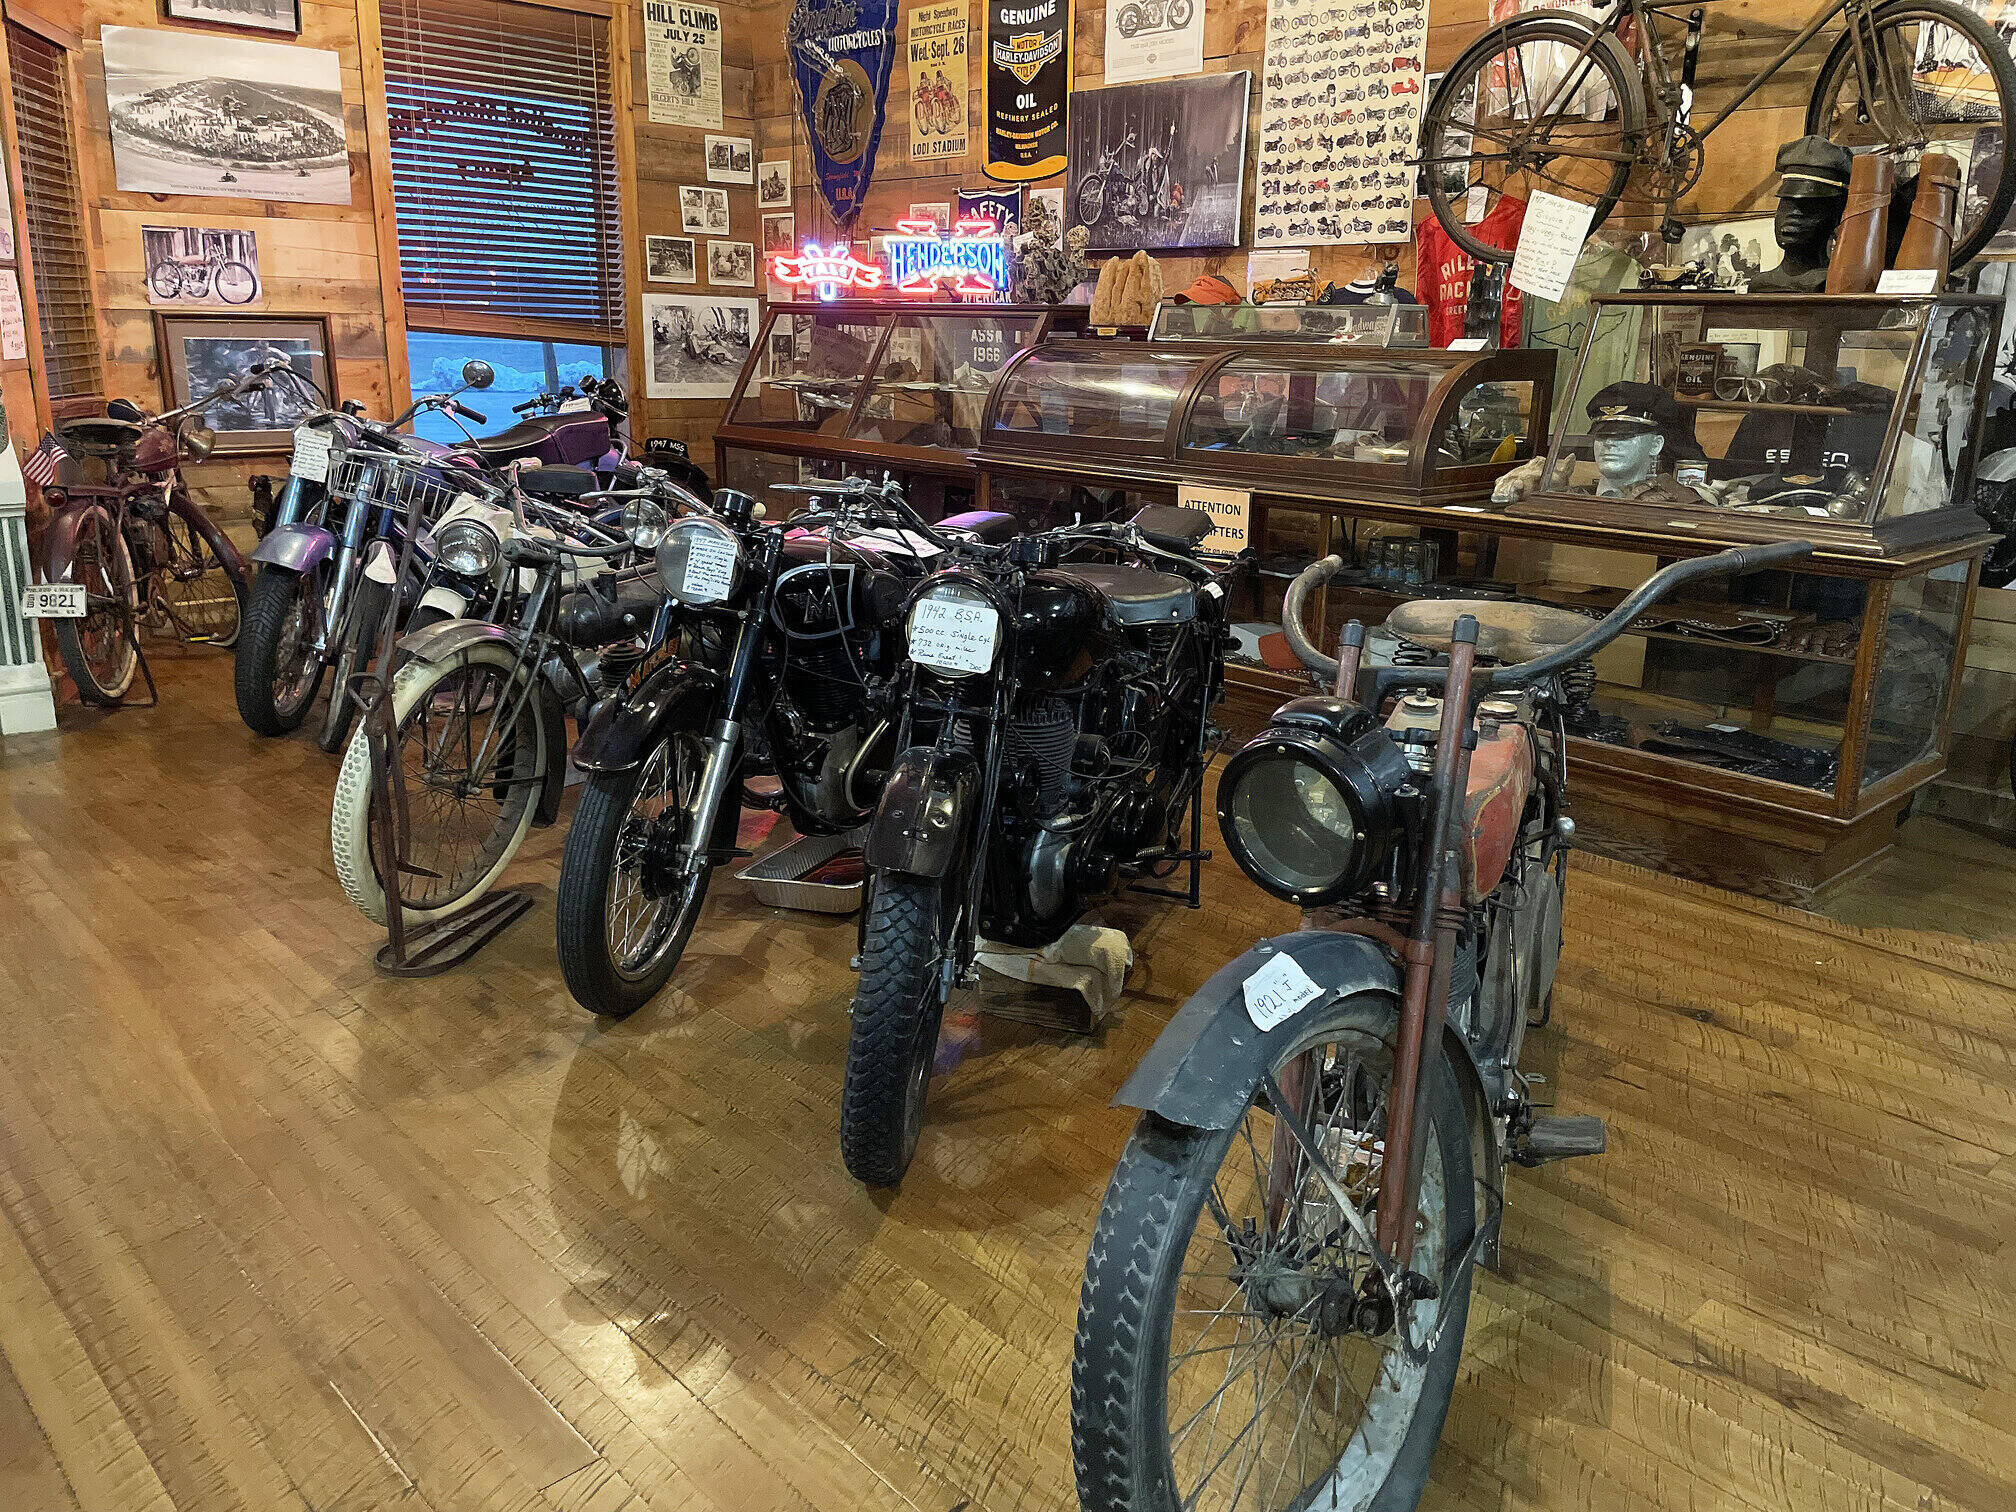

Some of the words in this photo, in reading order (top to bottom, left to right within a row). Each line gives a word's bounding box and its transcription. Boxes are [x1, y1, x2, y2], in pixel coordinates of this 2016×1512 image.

[646, 2, 676, 25] HILL
[679, 8, 719, 32] CLIMB
[933, 6, 959, 21] Speedway
[1000, 0, 1057, 25] GENUINE
[663, 28, 690, 42] JULY
[692, 33, 706, 45] 25
[910, 24, 946, 38] MOTORCYCLE
[947, 19, 967, 34] RACES
[953, 35, 965, 56] 26
[996, 39, 1060, 63] HARLEY-DAVIDSON
[1016, 39, 1038, 50] MOTOR
[1016, 64, 1037, 78] CYCLES
[1015, 93, 1038, 110] OIL
[996, 110, 1030, 123] REFINERY
[1031, 102, 1059, 121] SEALED
[912, 141, 930, 156] LODI
[932, 138, 967, 154] STADIUM
[891, 241, 1007, 289] HENDERSON
[973, 346, 1001, 362] 1966
[1680, 353, 1716, 362] GENUINE
[1685, 375, 1703, 385] OIL
[650, 439, 668, 448] 1947
[1184, 499, 1241, 516] ATTENTION
[39, 594, 77, 608] 9821
[921, 603, 947, 620] 1942
[918, 637, 932, 648] 732
[1293, 986, 1314, 1004] MODEL
[1253, 989, 1287, 1019] 1921
